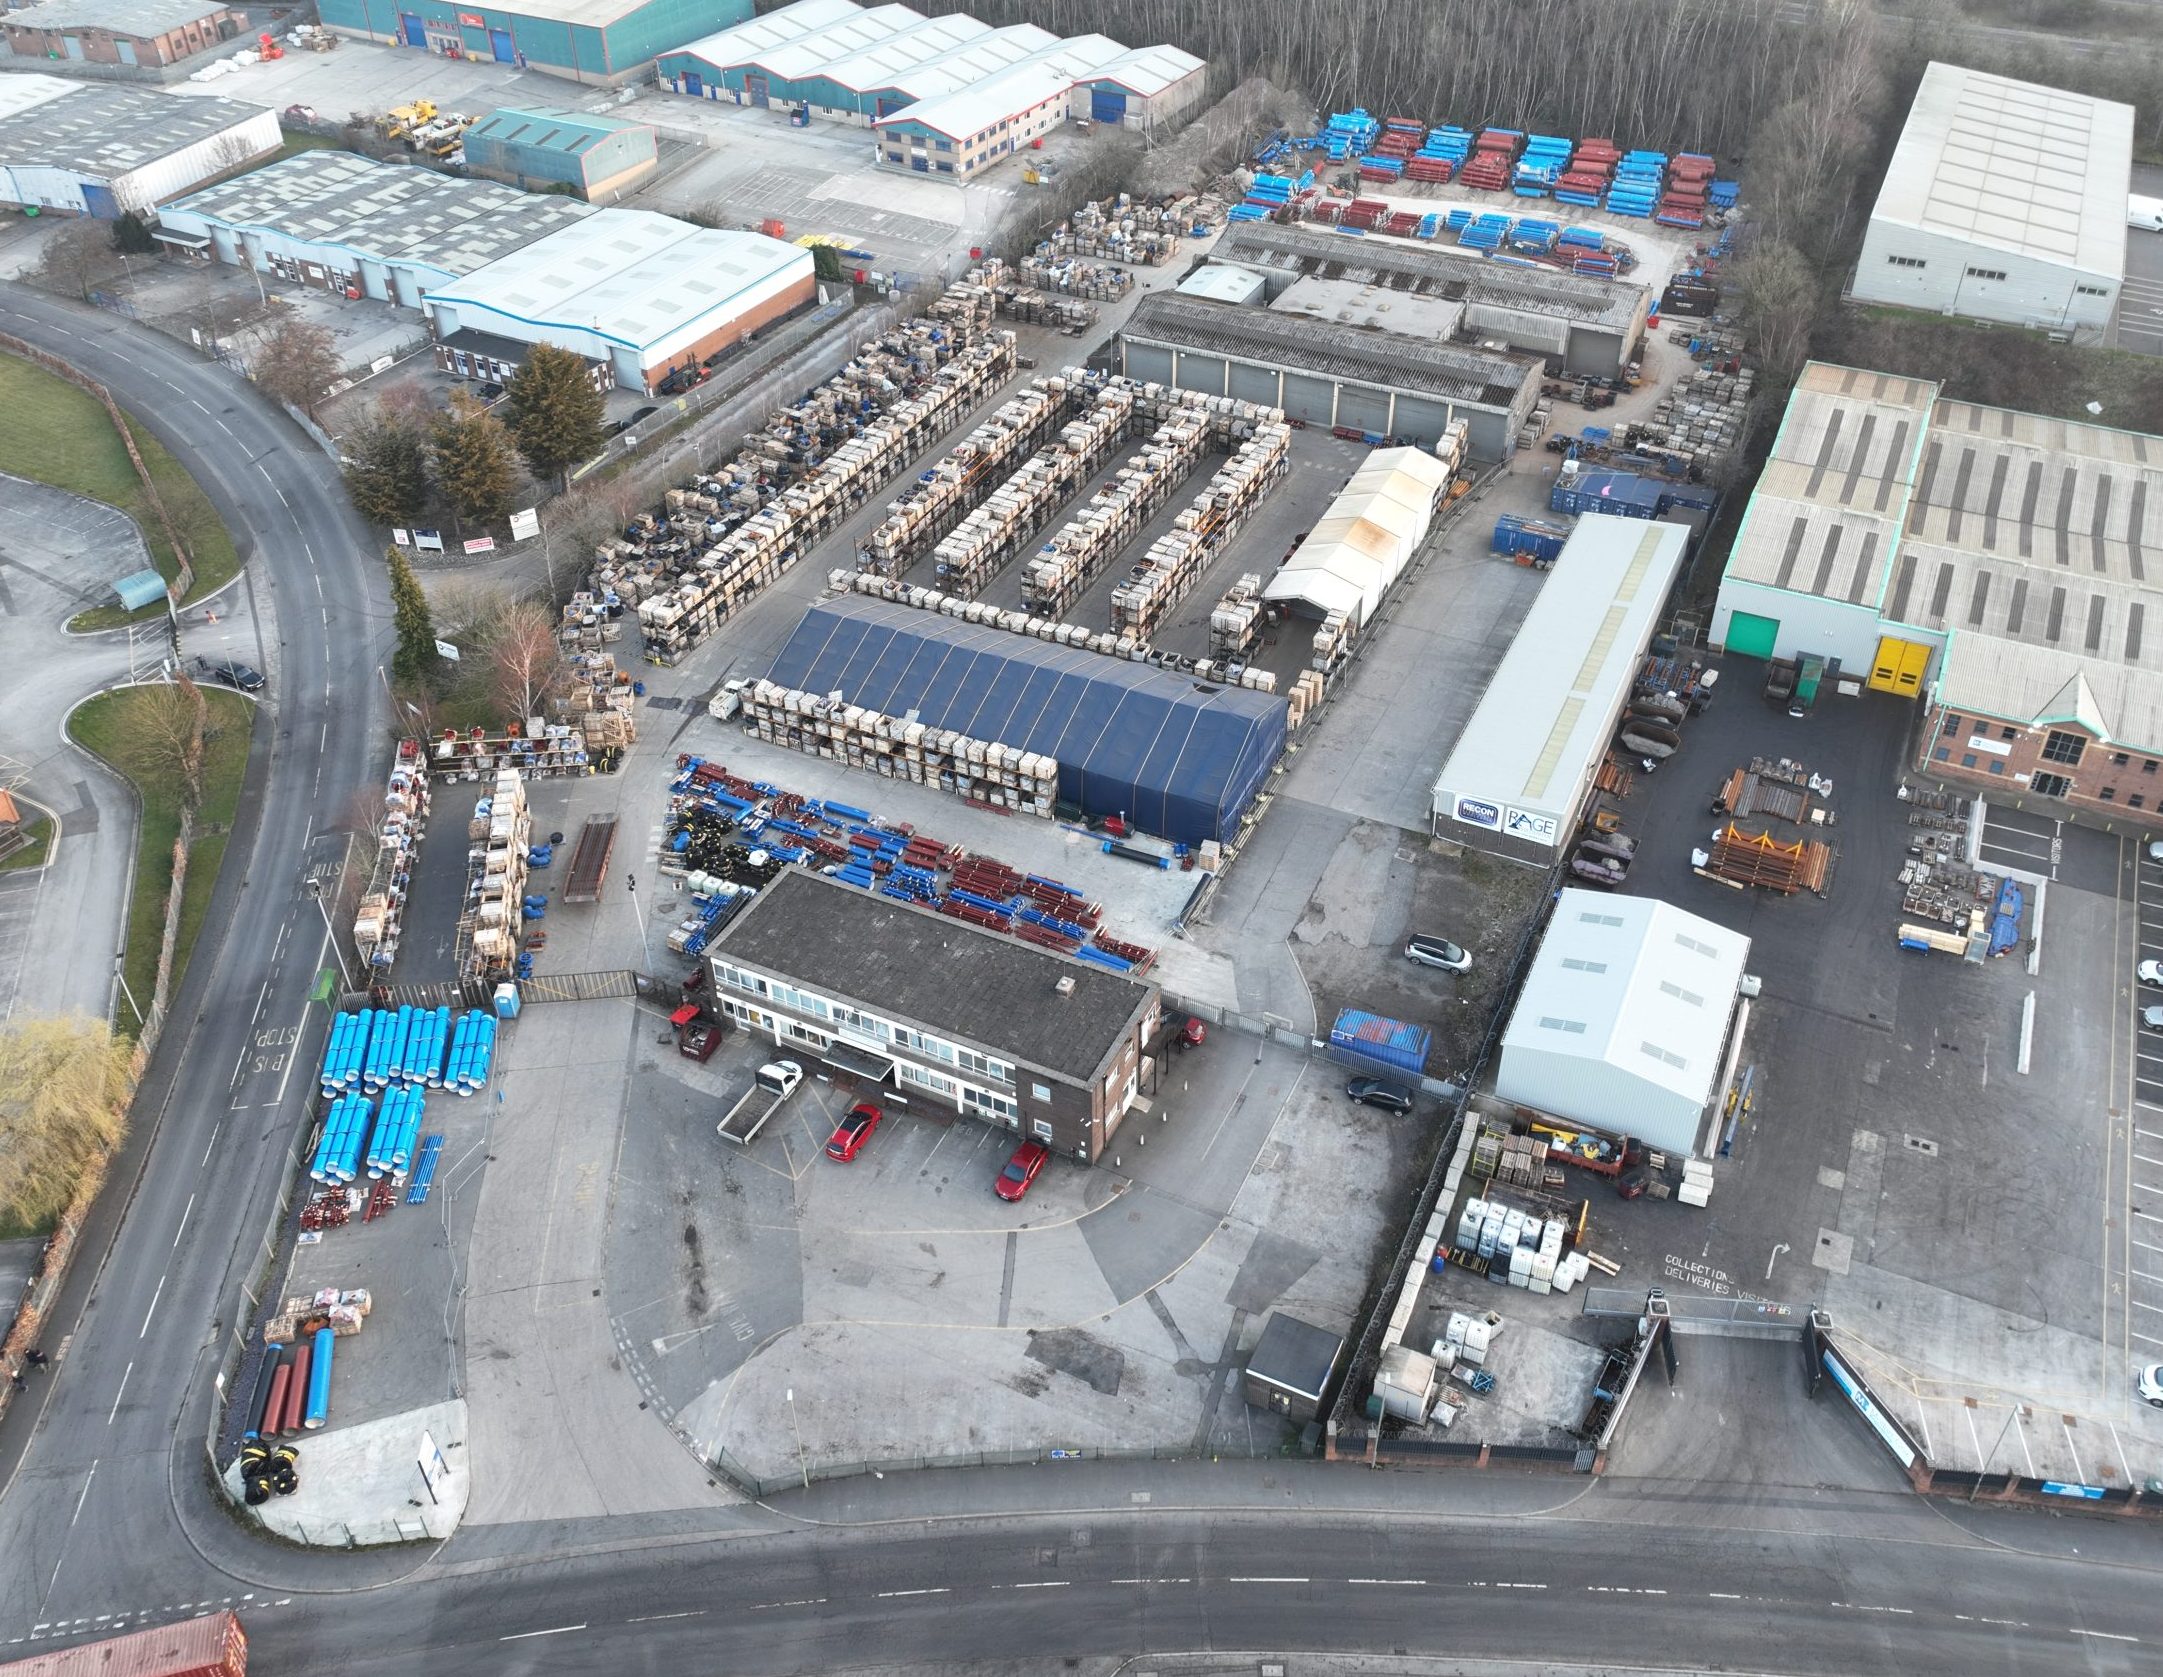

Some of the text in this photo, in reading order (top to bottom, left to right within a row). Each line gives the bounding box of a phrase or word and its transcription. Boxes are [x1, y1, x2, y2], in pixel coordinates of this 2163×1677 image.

[1463, 803, 1494, 817] RECON
[1508, 810, 1554, 835] RAGE
[2051, 838, 2062, 865] VISITORS
[1664, 1265, 1730, 1295] DELIVERIES
